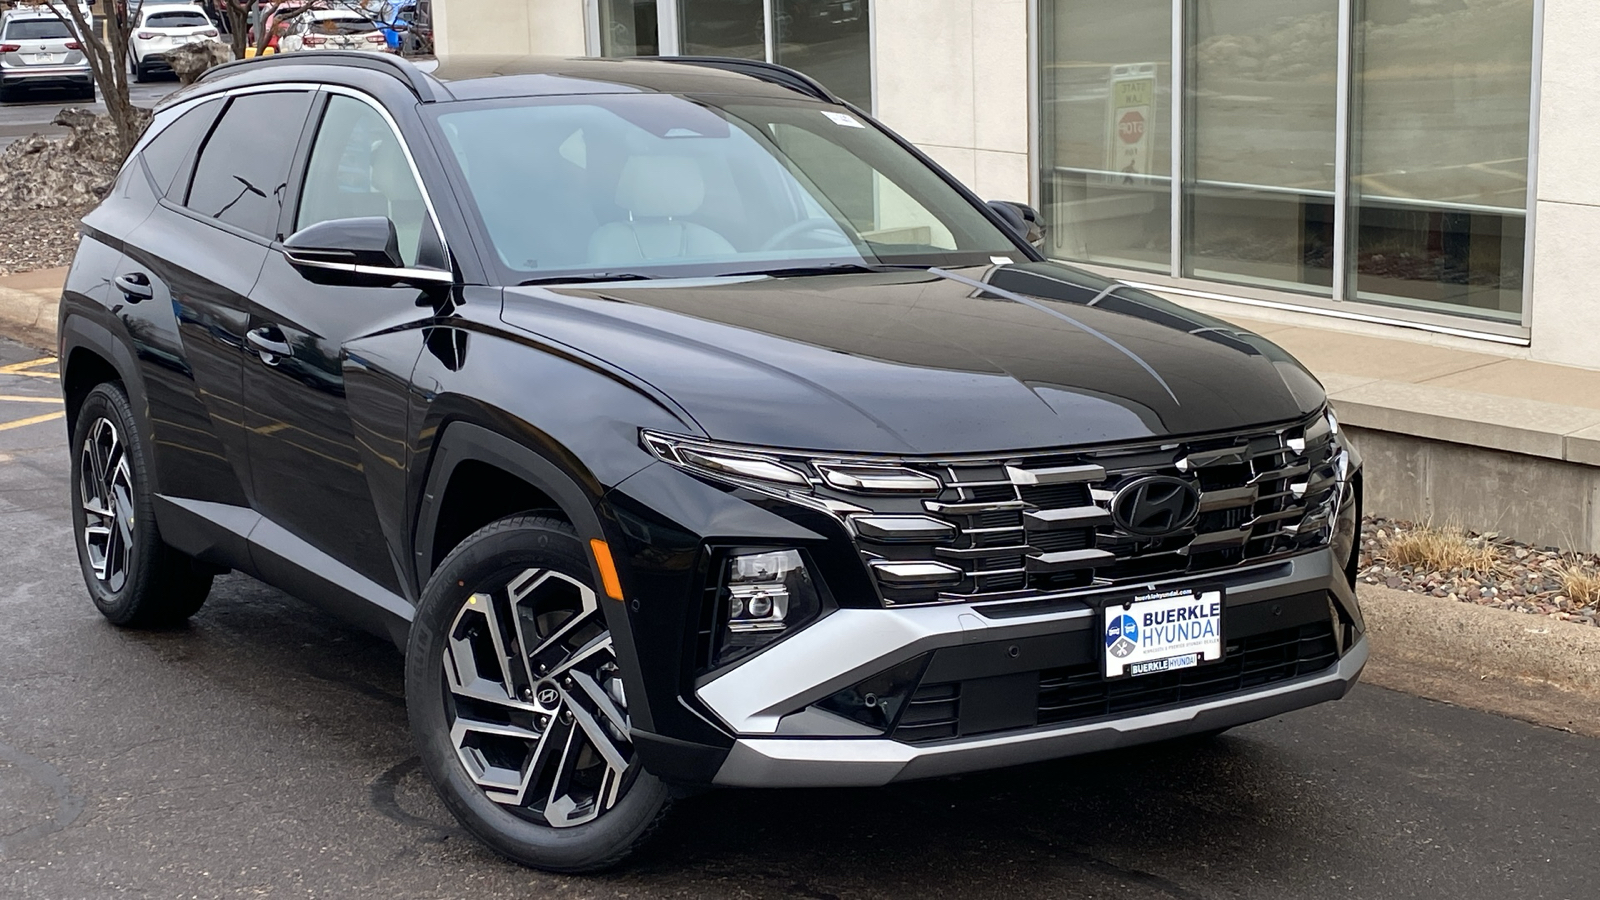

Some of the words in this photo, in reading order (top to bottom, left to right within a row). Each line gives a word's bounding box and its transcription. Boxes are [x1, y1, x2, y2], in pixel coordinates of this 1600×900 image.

[1143, 603, 1220, 627] BUERKLE
[1143, 618, 1220, 647] HYUNDAI
[1132, 660, 1168, 674] BUERKLE
[1169, 656, 1196, 667] HYUNDAI
